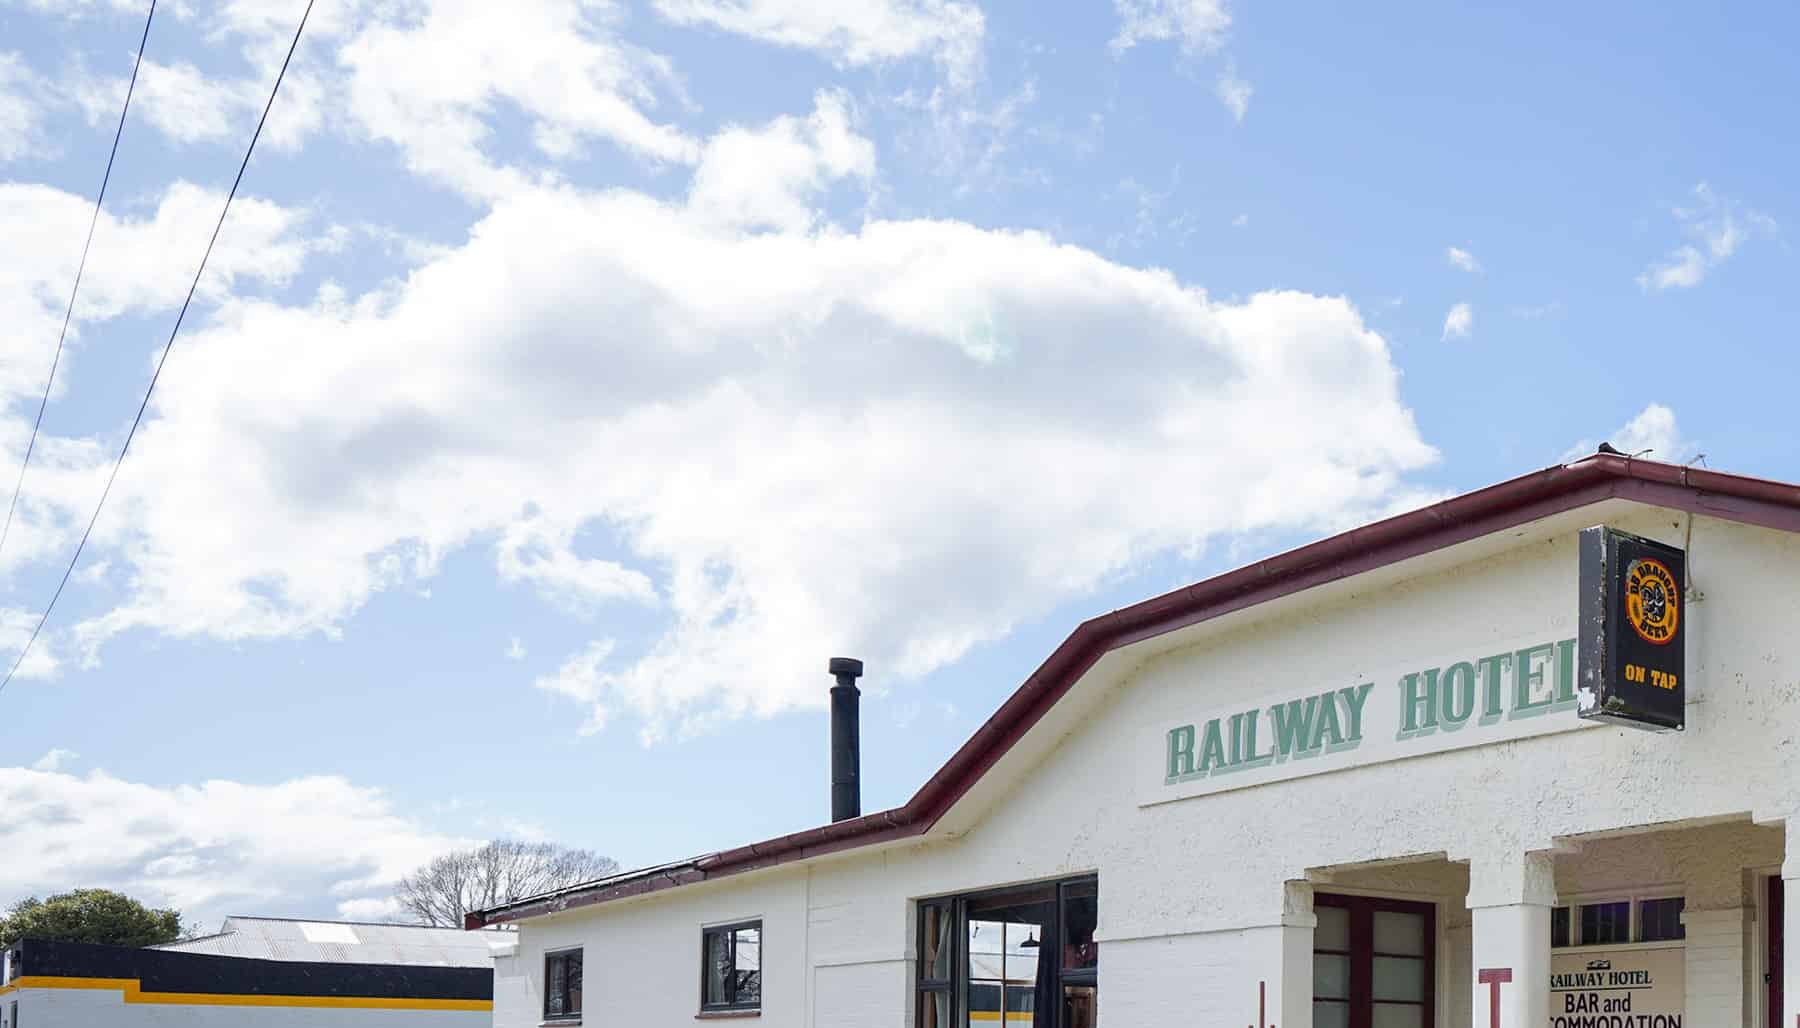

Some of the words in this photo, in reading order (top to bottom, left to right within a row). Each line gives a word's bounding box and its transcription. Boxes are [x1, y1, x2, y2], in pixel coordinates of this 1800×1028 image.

[1637, 563, 1675, 608] DRAUGHT
[1640, 619, 1669, 638] BEER
[1625, 664, 1646, 683] ON
[1651, 670, 1678, 690] TAP
[1164, 683, 1375, 785] RAILWAY
[1609, 970, 1653, 985] HOTEL
[1565, 993, 1599, 1014] BAR
[1603, 991, 1631, 1013] and
